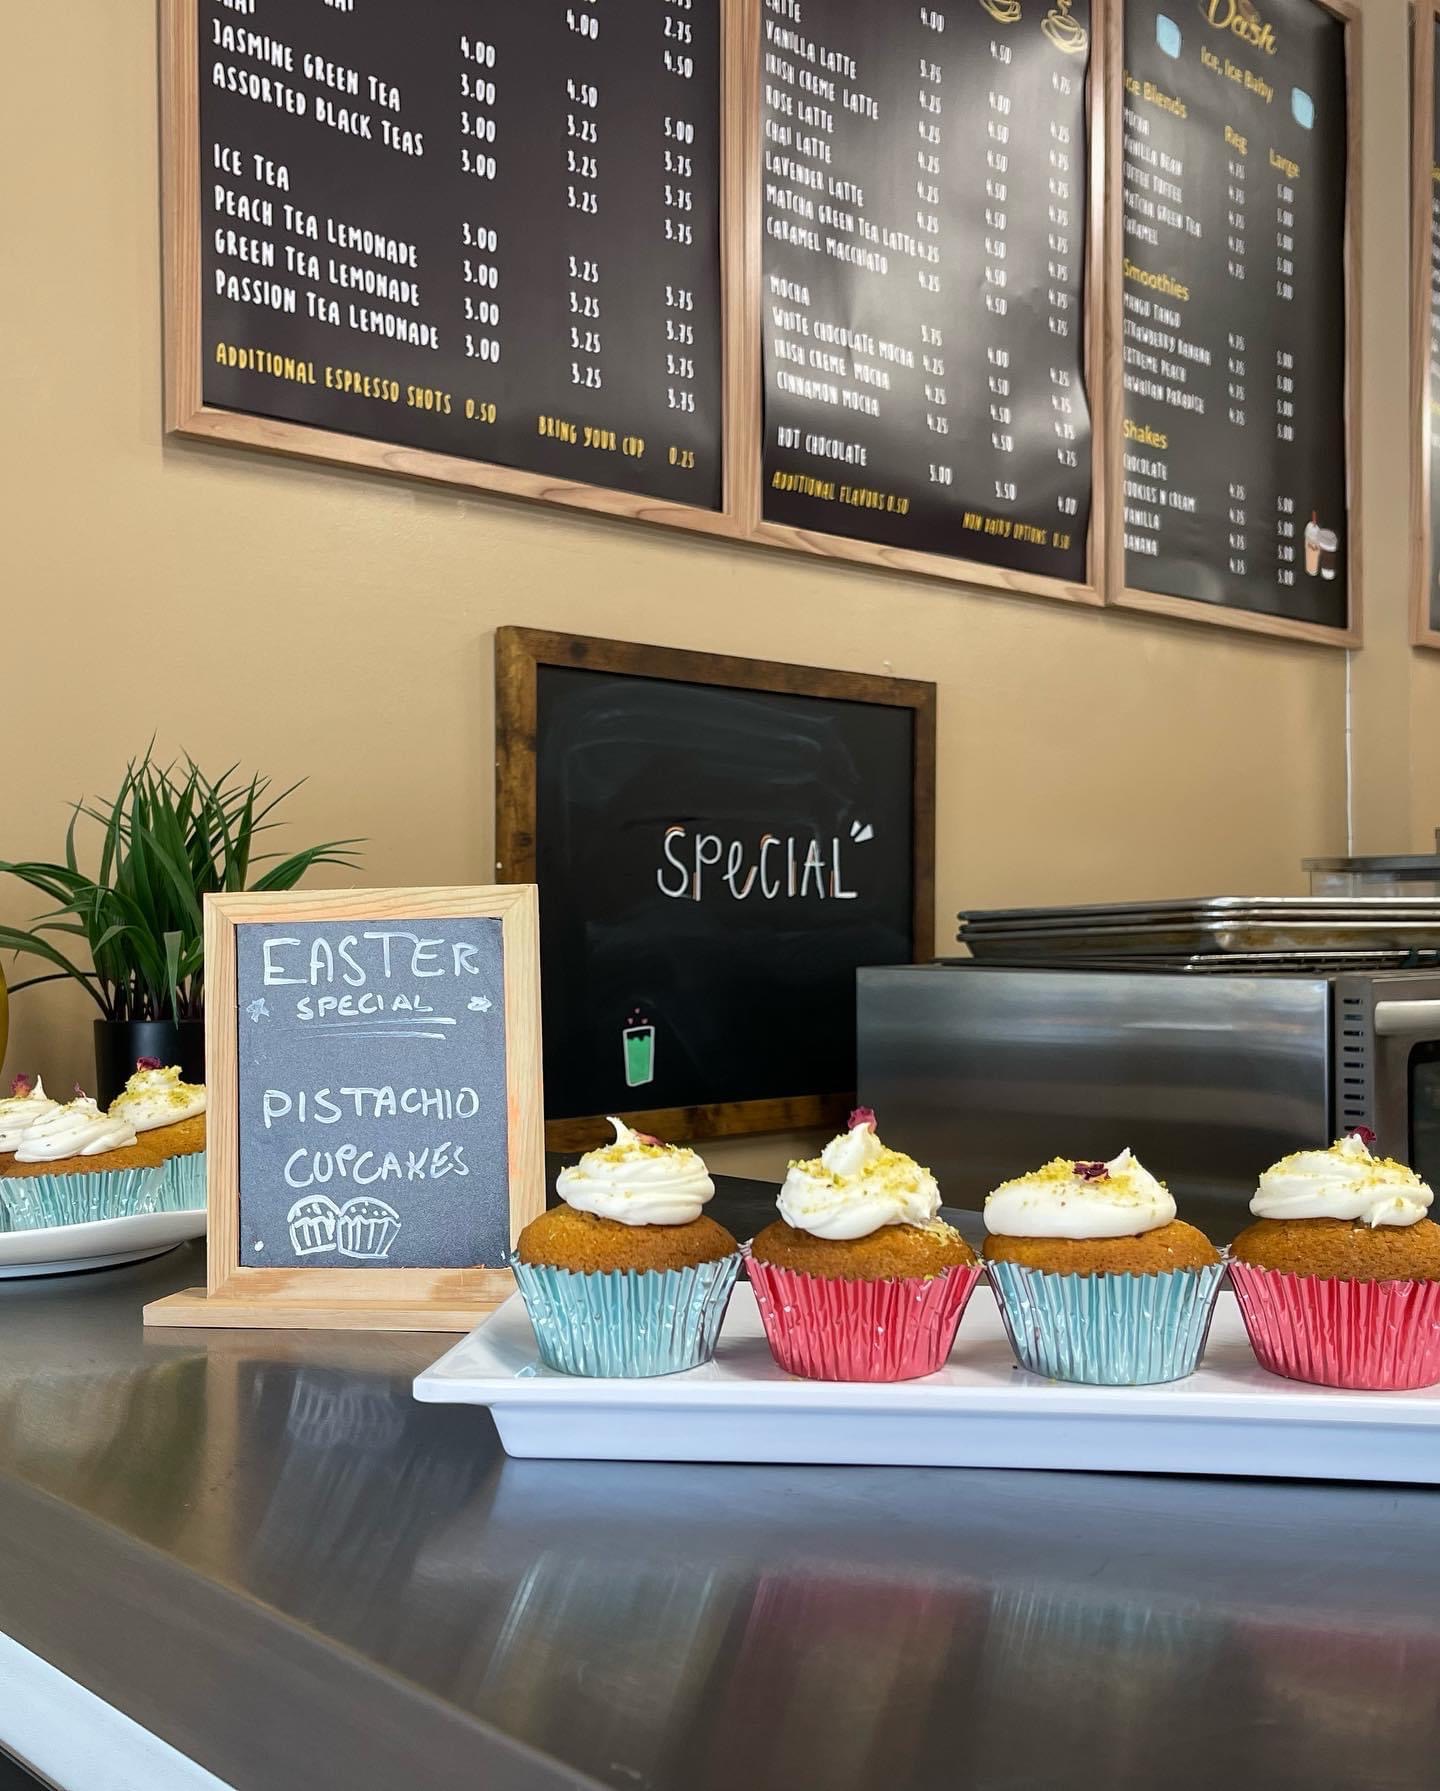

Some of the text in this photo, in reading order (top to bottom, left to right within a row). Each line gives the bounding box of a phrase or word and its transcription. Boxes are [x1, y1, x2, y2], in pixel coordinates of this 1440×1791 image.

[566, 8, 599, 40] 4.00
[664, 16, 692, 44] 2.75
[212, 18, 400, 112] JASMINE GREEN TEA
[460, 35, 496, 69] 4.00
[664, 49, 693, 79] 4.50
[766, 19, 857, 80] VANILLA LATTE
[460, 73, 496, 106] 3.00
[566, 78, 598, 109] 4.50
[766, 53, 879, 120] IRISH CREME LATTE
[212, 62, 423, 156] ASSORTED BLACK TEAS
[766, 84, 834, 133] ROSE LATTE
[461, 111, 496, 143] 3.00
[567, 114, 598, 143] 3.25
[664, 116, 694, 145] 5.00
[766, 119, 832, 165] CHAI LATTE
[213, 143, 289, 192] ICE TEA
[461, 149, 497, 180] 3.00
[567, 150, 598, 179] 3.25
[664, 150, 692, 178] 3.75
[765, 150, 864, 208] LAVENDER LATTE
[567, 186, 598, 214] 3.25
[664, 184, 692, 212] 3.75
[214, 184, 418, 268] PEACH TEA LEMONADE
[664, 218, 693, 246] 3.75
[766, 183, 916, 257] MATCHA GREEN TEA LATTE
[767, 216, 822, 252] CARAMEL
[462, 222, 497, 253] 3.00
[214, 228, 420, 307] GREEN TEA LEMONADE
[463, 259, 498, 289] 3.00
[568, 255, 599, 284] 3.25
[1123, 258, 1190, 301] Smoothies
[569, 291, 600, 319] 3.25
[665, 285, 693, 312] 3.75
[770, 275, 811, 307] MOCHA
[215, 269, 439, 350] PASSION TEA LEMONADE
[464, 297, 499, 326] 3.00
[570, 326, 601, 354] 3.25
[666, 319, 694, 345] 3.75
[772, 306, 915, 369] WHITE CHOCOLATE MOCHA
[465, 334, 500, 363] 3.00
[216, 342, 497, 424] ADDITIONAL ESPRESSO SHOTS 0.50
[571, 362, 602, 389] 3.25
[667, 354, 694, 380] 3.75
[853, 362, 891, 391] MOCHA
[668, 388, 696, 413] 3.75
[776, 371, 881, 418] CINNAMON MOCHA
[537, 415, 577, 445] BRING
[622, 436, 645, 458] CUP
[668, 446, 695, 468] 0.25
[777, 426, 867, 467] HOT CHOCOLATE
[1123, 419, 1169, 449] Shakes
[771, 470, 910, 515] ADDITIONAL FLAVORS 0.50
[962, 511, 983, 531] NON
[1013, 523, 1048, 545] OPTIONS
[262, 931, 480, 986] EASTER
[296, 992, 434, 1021] SPECIAL
[263, 1085, 480, 1129] PISTACHIO
[284, 1141, 470, 1188] CUPCAKES
